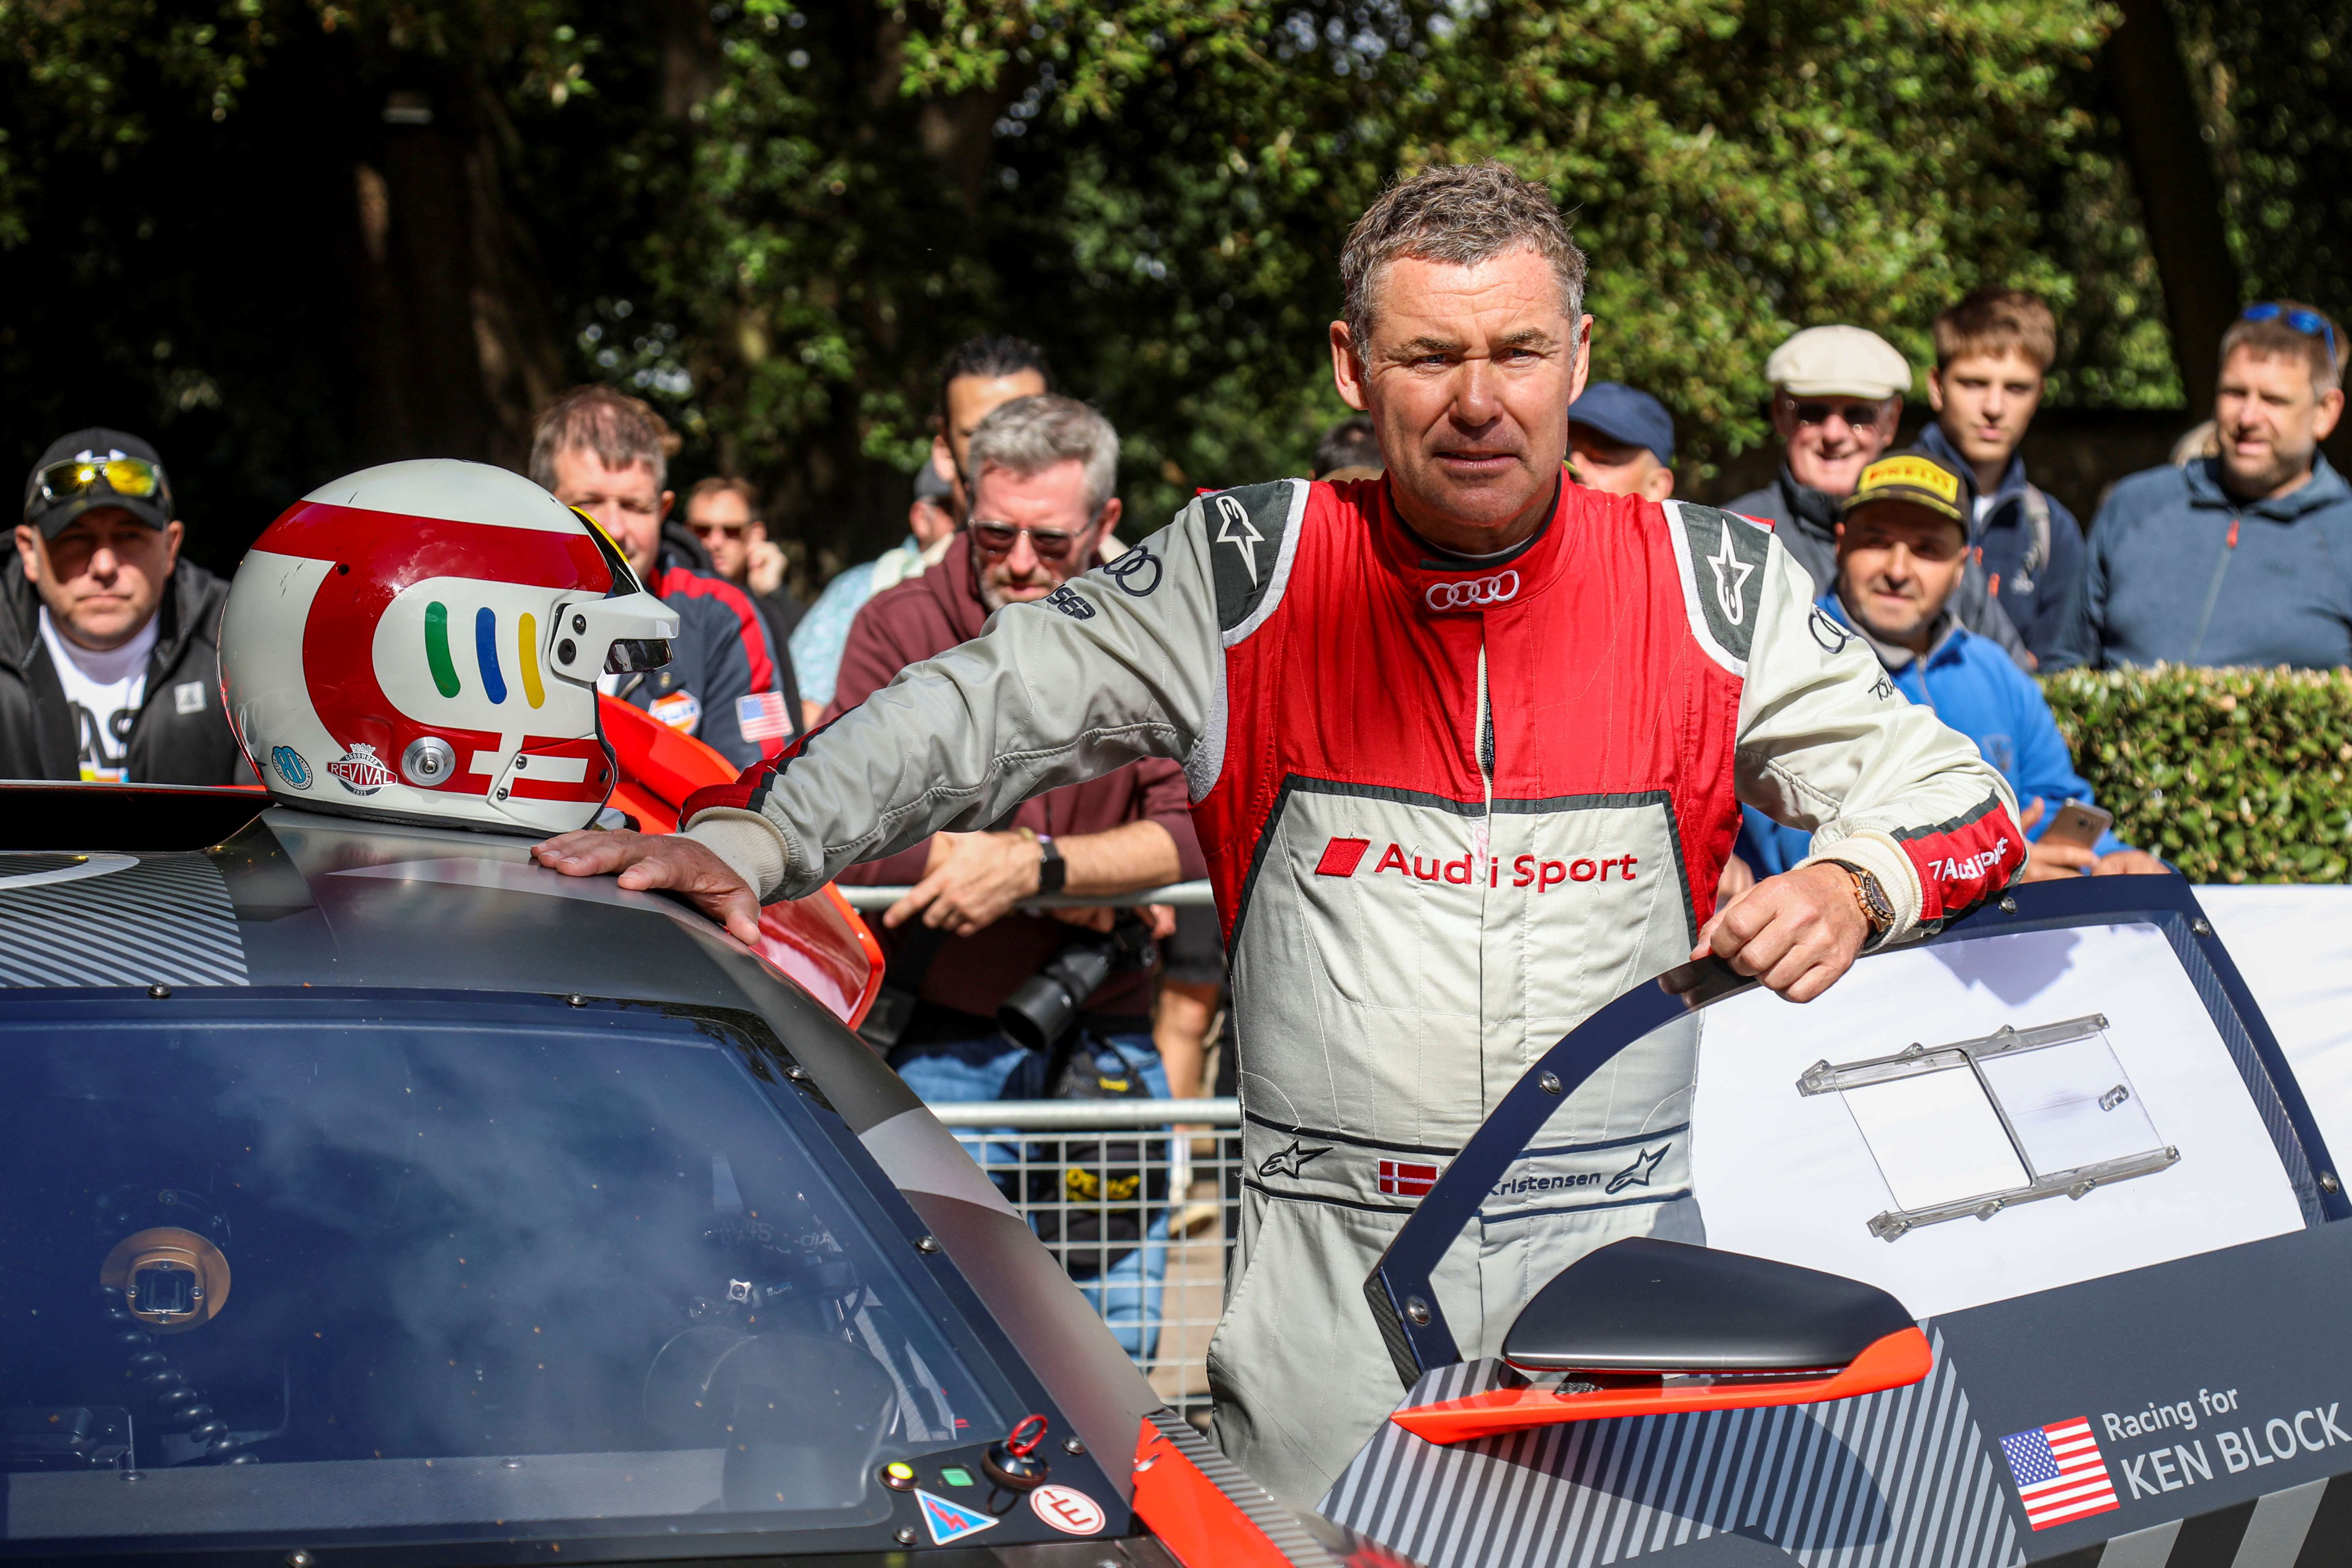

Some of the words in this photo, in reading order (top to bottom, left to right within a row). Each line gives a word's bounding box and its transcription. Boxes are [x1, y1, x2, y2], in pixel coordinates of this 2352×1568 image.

[273, 746, 306, 783] 80
[331, 763, 393, 785] REVIVAL
[345, 753, 378, 765] GOODWOOD
[1374, 843, 1498, 888] Audi
[1512, 853, 1637, 893] Sport
[2102, 1401, 2198, 1442] Racing
[2198, 1388, 2238, 1417] for
[2120, 1439, 2214, 1500] KEN
[2215, 1402, 2352, 1474] BLOCK
